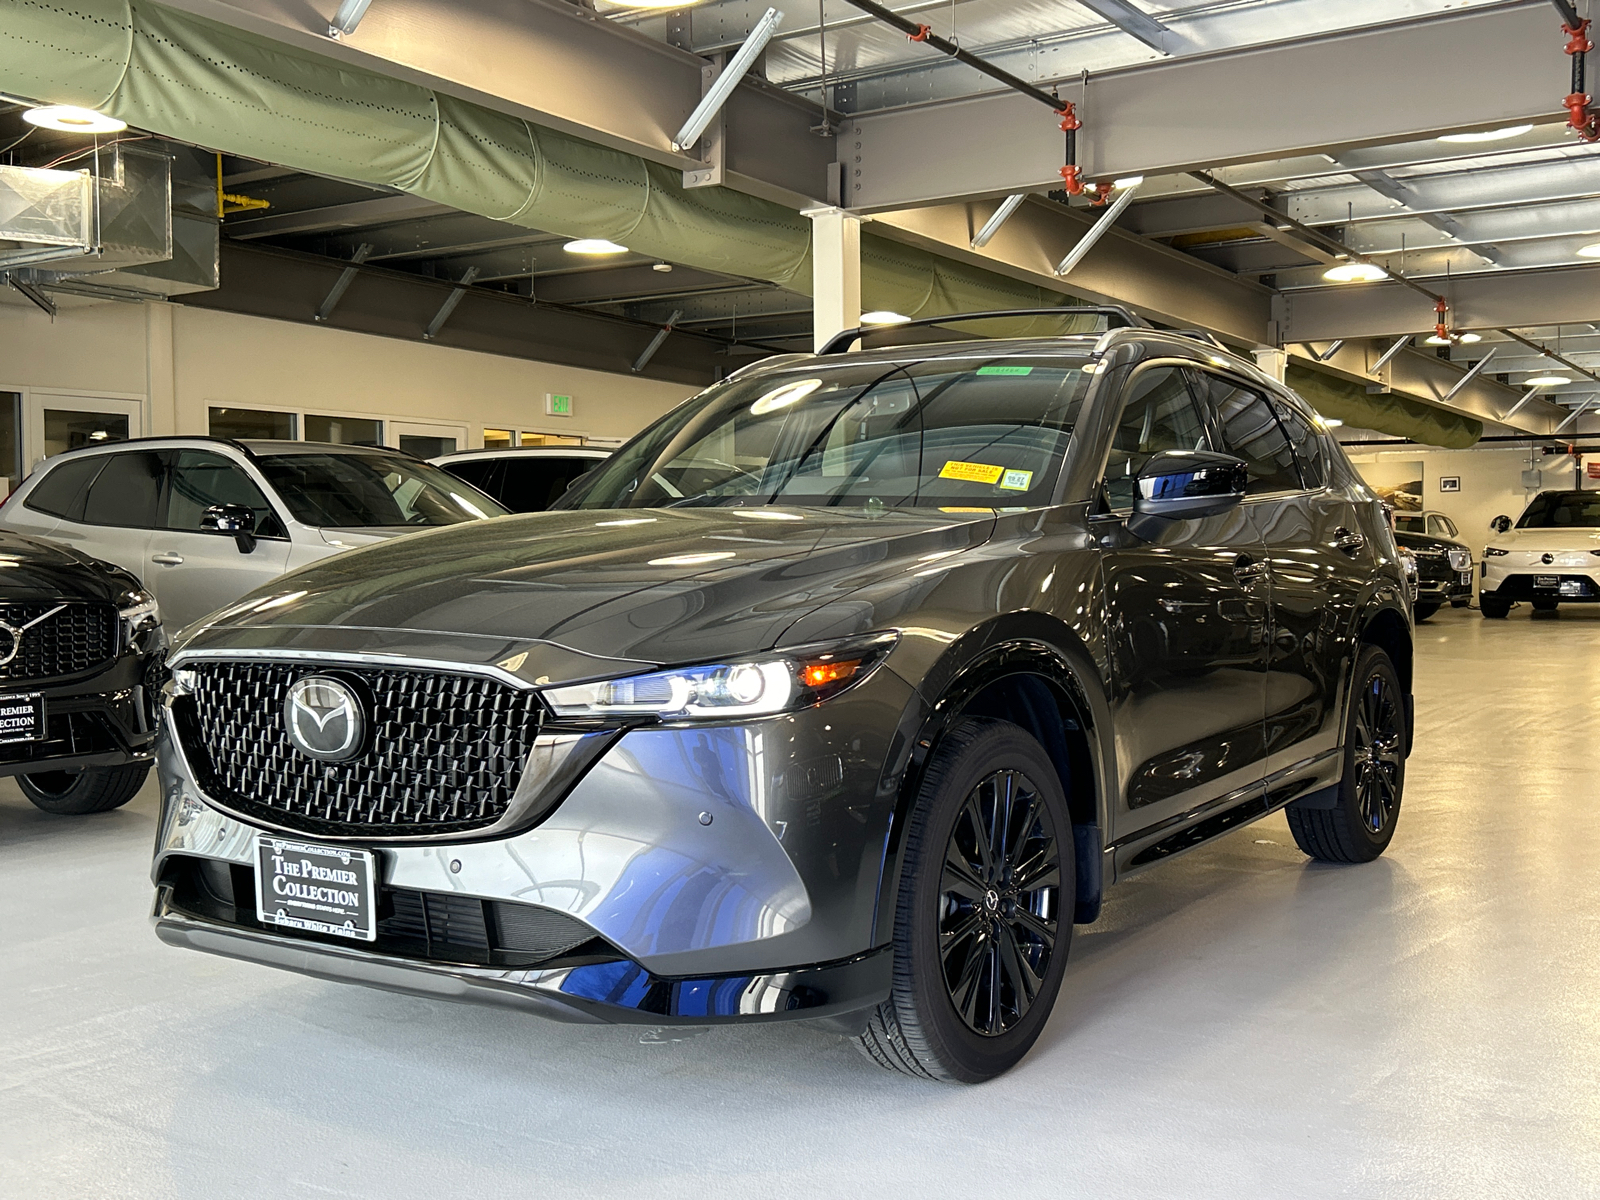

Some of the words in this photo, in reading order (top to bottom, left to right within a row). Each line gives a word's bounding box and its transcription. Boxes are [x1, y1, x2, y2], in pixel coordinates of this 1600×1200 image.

[554, 395, 569, 413] EXIT
[271, 855, 300, 876] THE
[300, 859, 358, 886] PREMIER
[273, 875, 359, 907] COLLECTION
[304, 921, 328, 932] White
[330, 925, 356, 937] Plains
